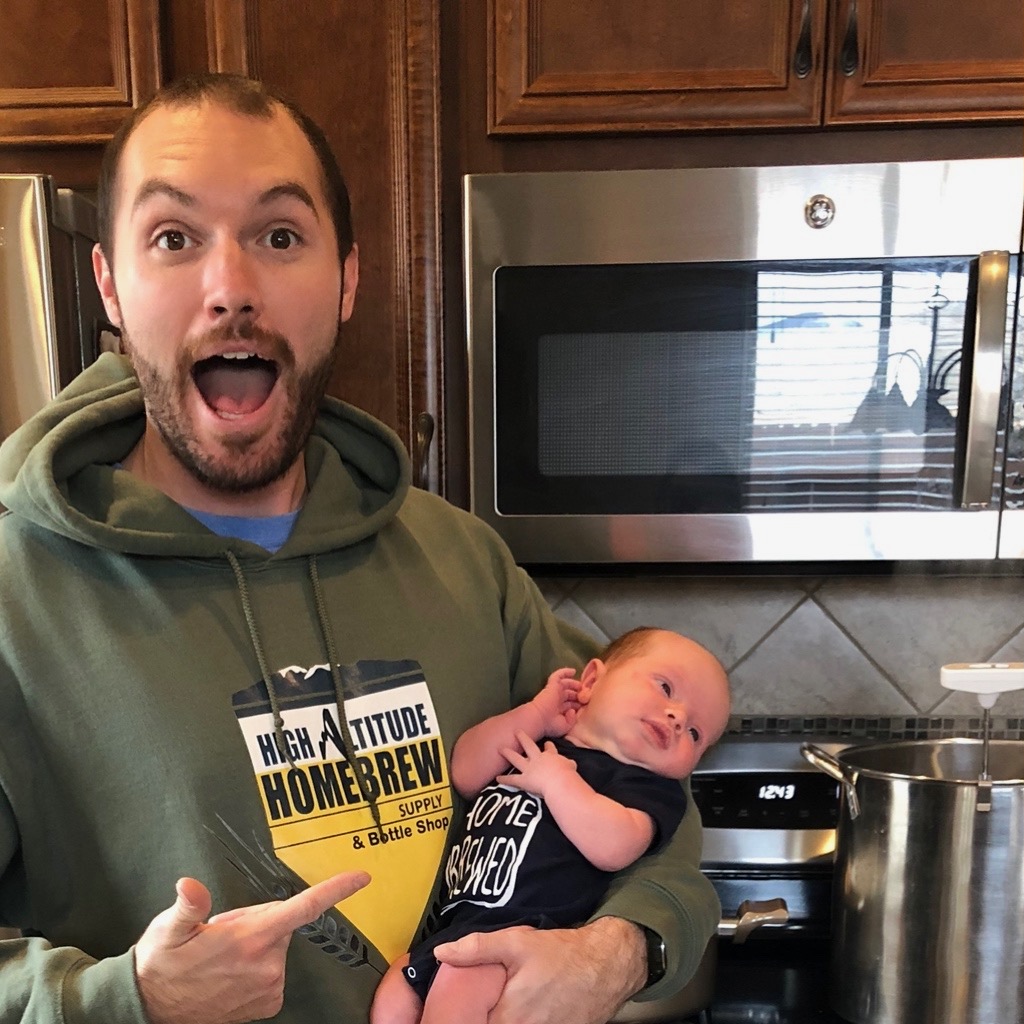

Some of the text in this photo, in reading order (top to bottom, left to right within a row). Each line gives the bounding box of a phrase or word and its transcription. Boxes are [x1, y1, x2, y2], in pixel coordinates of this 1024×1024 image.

[256, 727, 316, 767] HIGH
[260, 738, 444, 821] HOMEBREW
[398, 794, 443, 817] SUPPLY
[352, 816, 449, 850] & Bottle Shop
